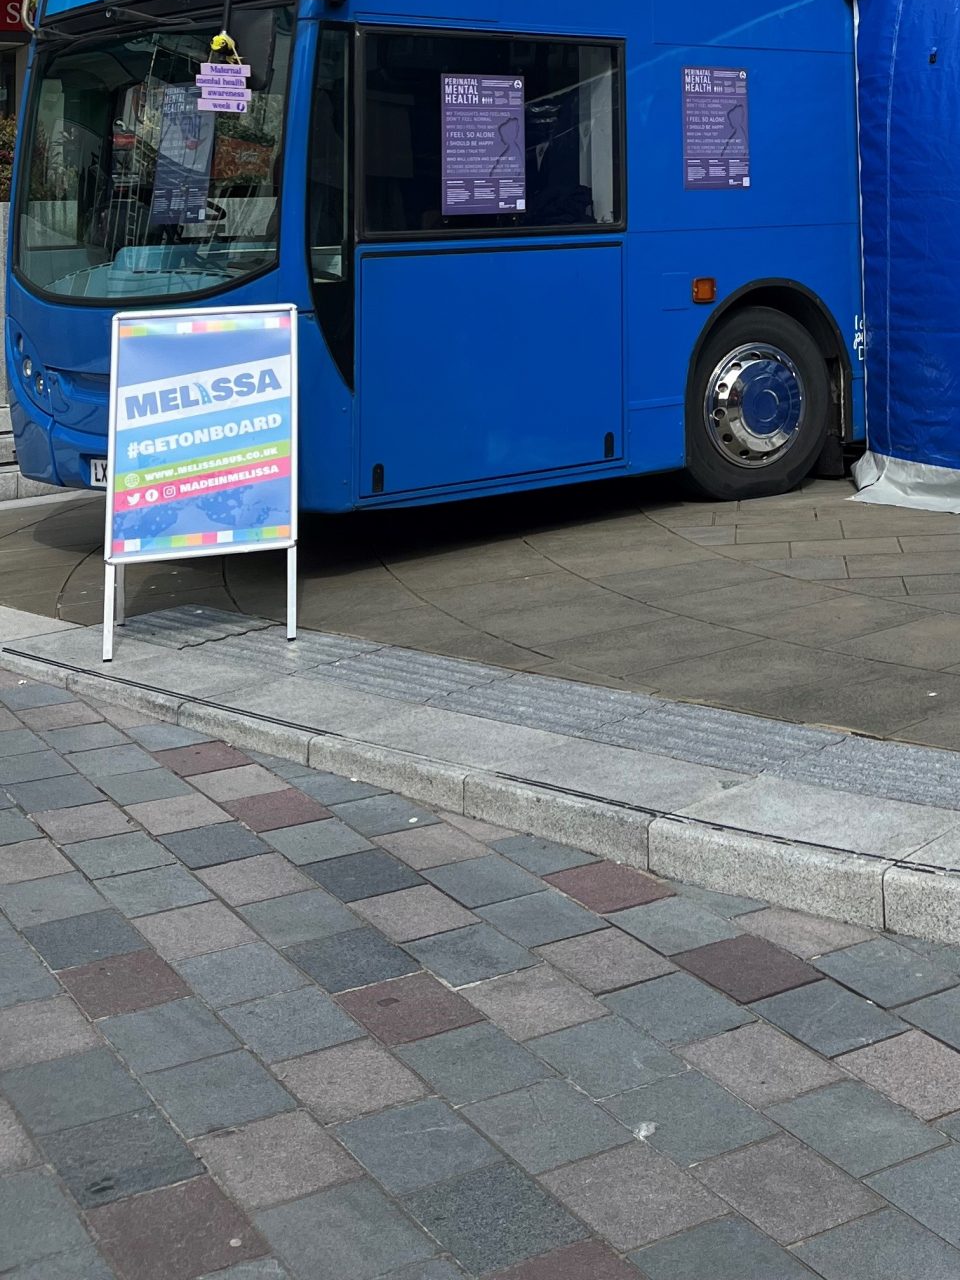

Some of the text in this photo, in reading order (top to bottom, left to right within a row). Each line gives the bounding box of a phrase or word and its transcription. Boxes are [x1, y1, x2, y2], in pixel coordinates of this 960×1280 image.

[210, 66, 242, 74] Maternal
[196, 77, 245, 86] mental health
[444, 77, 479, 86] PERINATAL
[685, 75, 711, 83] MENTAL
[444, 85, 479, 95] MENTAL
[685, 83, 712, 92] HEALTH
[445, 94, 479, 104] HEALTH
[124, 368, 282, 420] MELISSA
[127, 413, 282, 460] #GETONBOARD
[144, 447, 278, 482] WWW.MELISSABUS.CO.UK
[179, 464, 279, 493] MADEINMELISSA
